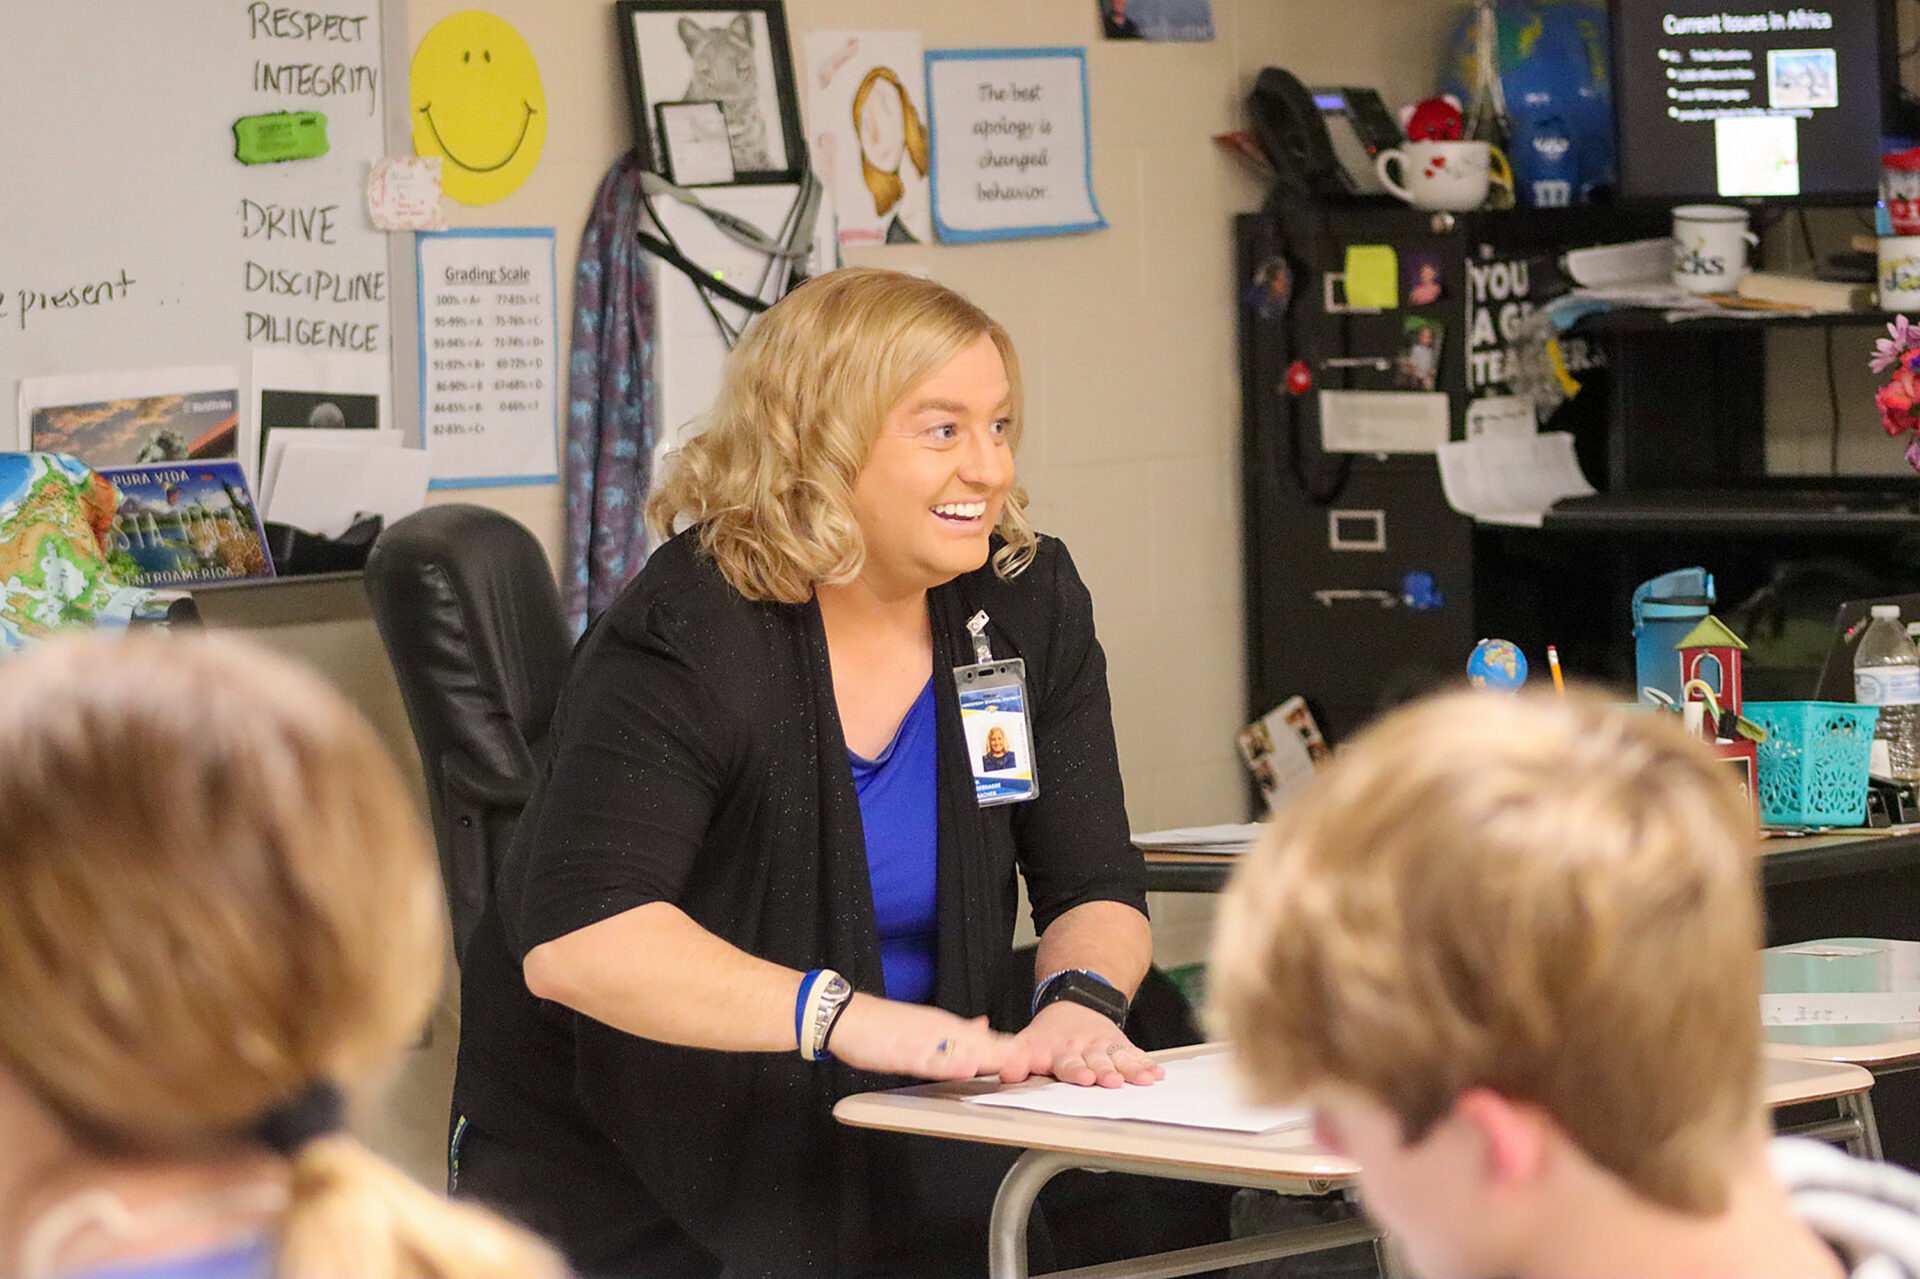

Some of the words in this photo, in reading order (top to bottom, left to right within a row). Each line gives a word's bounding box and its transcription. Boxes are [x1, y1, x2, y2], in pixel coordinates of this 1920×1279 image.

[248, 1, 368, 42] RESPECT
[1663, 14, 1721, 35] Current
[1787, 8, 1832, 30] Africa
[254, 60, 377, 117] INTEGRITY
[979, 83, 1005, 102] The
[1011, 83, 1042, 102] best
[973, 117, 1035, 140] apology
[979, 147, 1049, 172] changed
[242, 198, 338, 246] DRIVE
[245, 261, 385, 303] DISCIPLINE
[446, 266, 496, 285] Grading
[500, 266, 530, 282] Scale
[1472, 260, 1529, 301] YOU
[19, 269, 136, 330] present
[245, 311, 379, 352] DILIGENCE
[1472, 307, 1497, 346] A
[112, 473, 151, 486] PURA
[154, 470, 190, 483] VIDA
